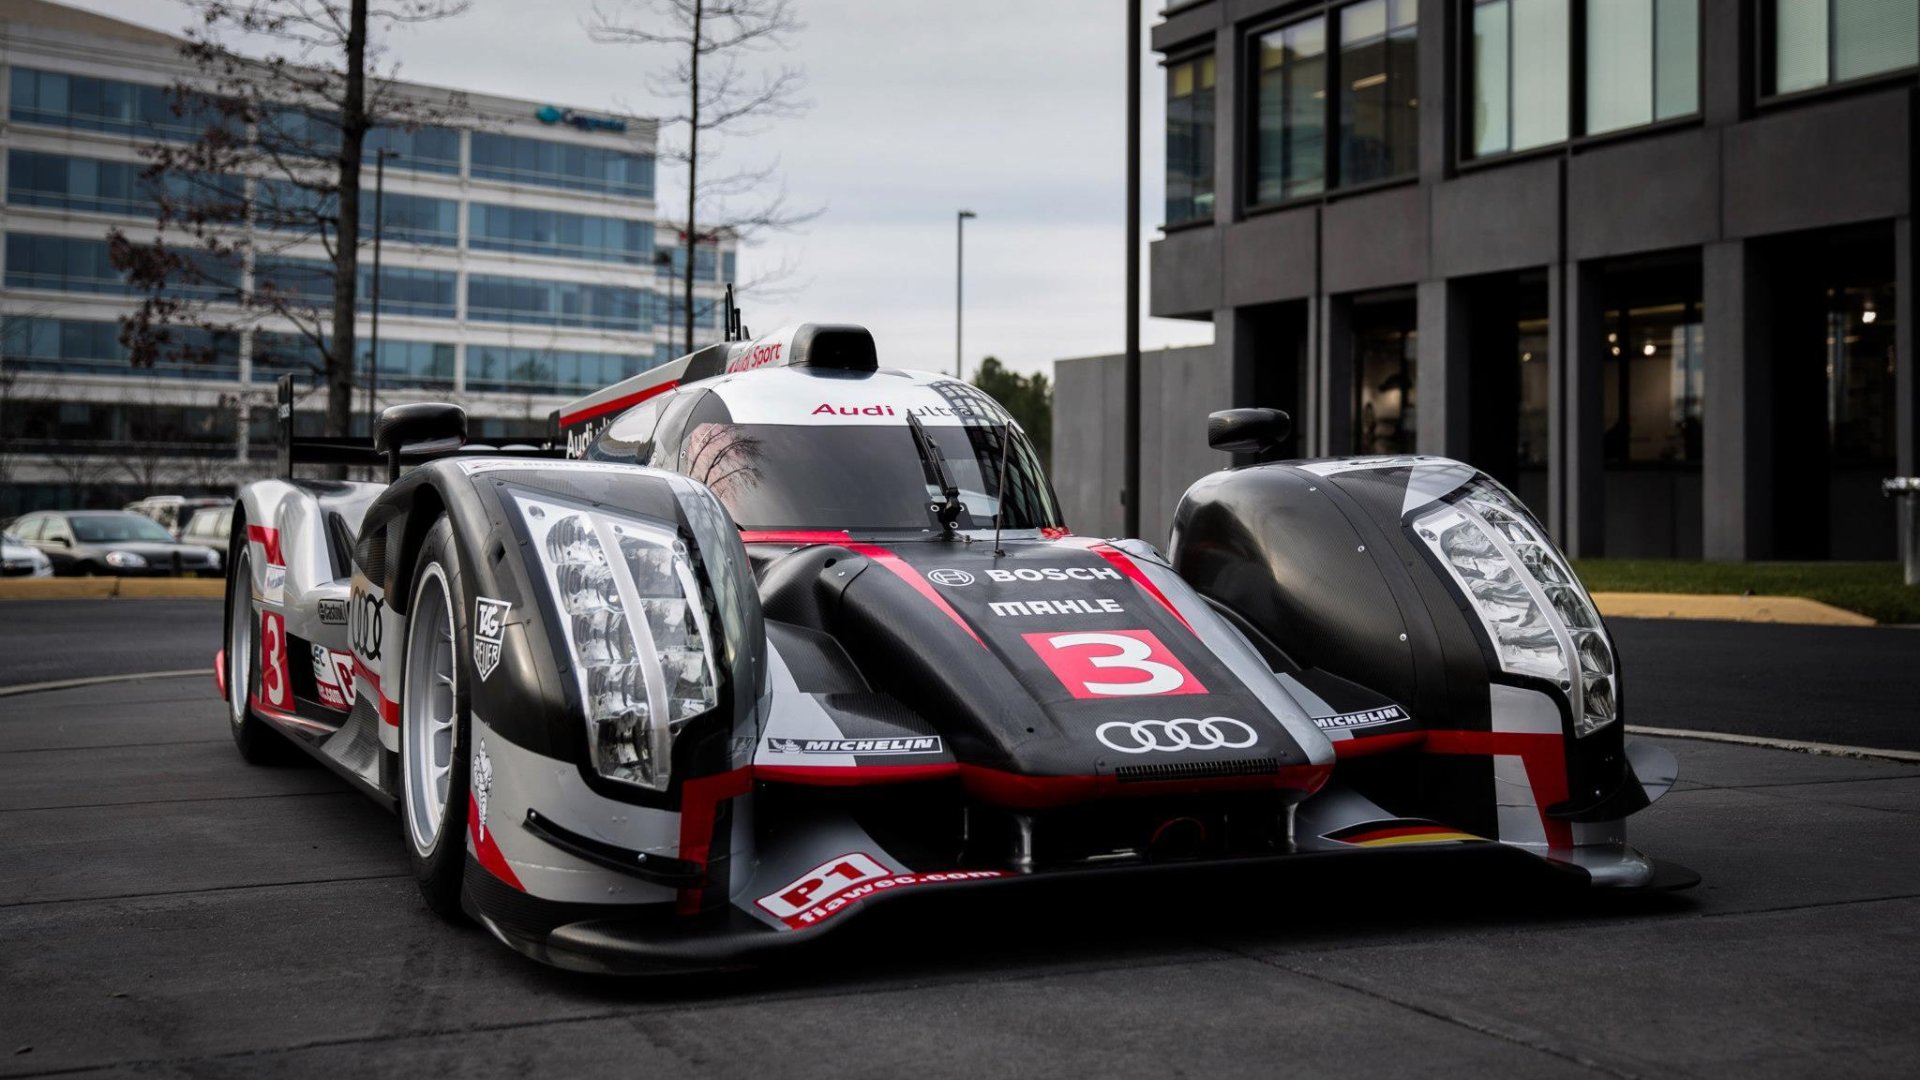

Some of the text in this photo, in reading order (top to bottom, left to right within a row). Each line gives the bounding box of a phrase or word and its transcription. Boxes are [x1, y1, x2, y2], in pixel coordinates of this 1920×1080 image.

[751, 343, 782, 367] Sport
[812, 403, 975, 416] Audi ultra
[566, 422, 593, 459] Audi
[984, 567, 1123, 583] BOSCH
[479, 604, 499, 637] TAG
[988, 598, 1125, 617] MAHLE
[267, 615, 284, 706] 3
[475, 641, 499, 674] HEUER
[1048, 633, 1184, 696] 3
[1313, 707, 1400, 728] MICHELIN
[804, 738, 935, 751] MICHELIN
[780, 861, 867, 909] P1
[799, 871, 1003, 924] fiawec.com
